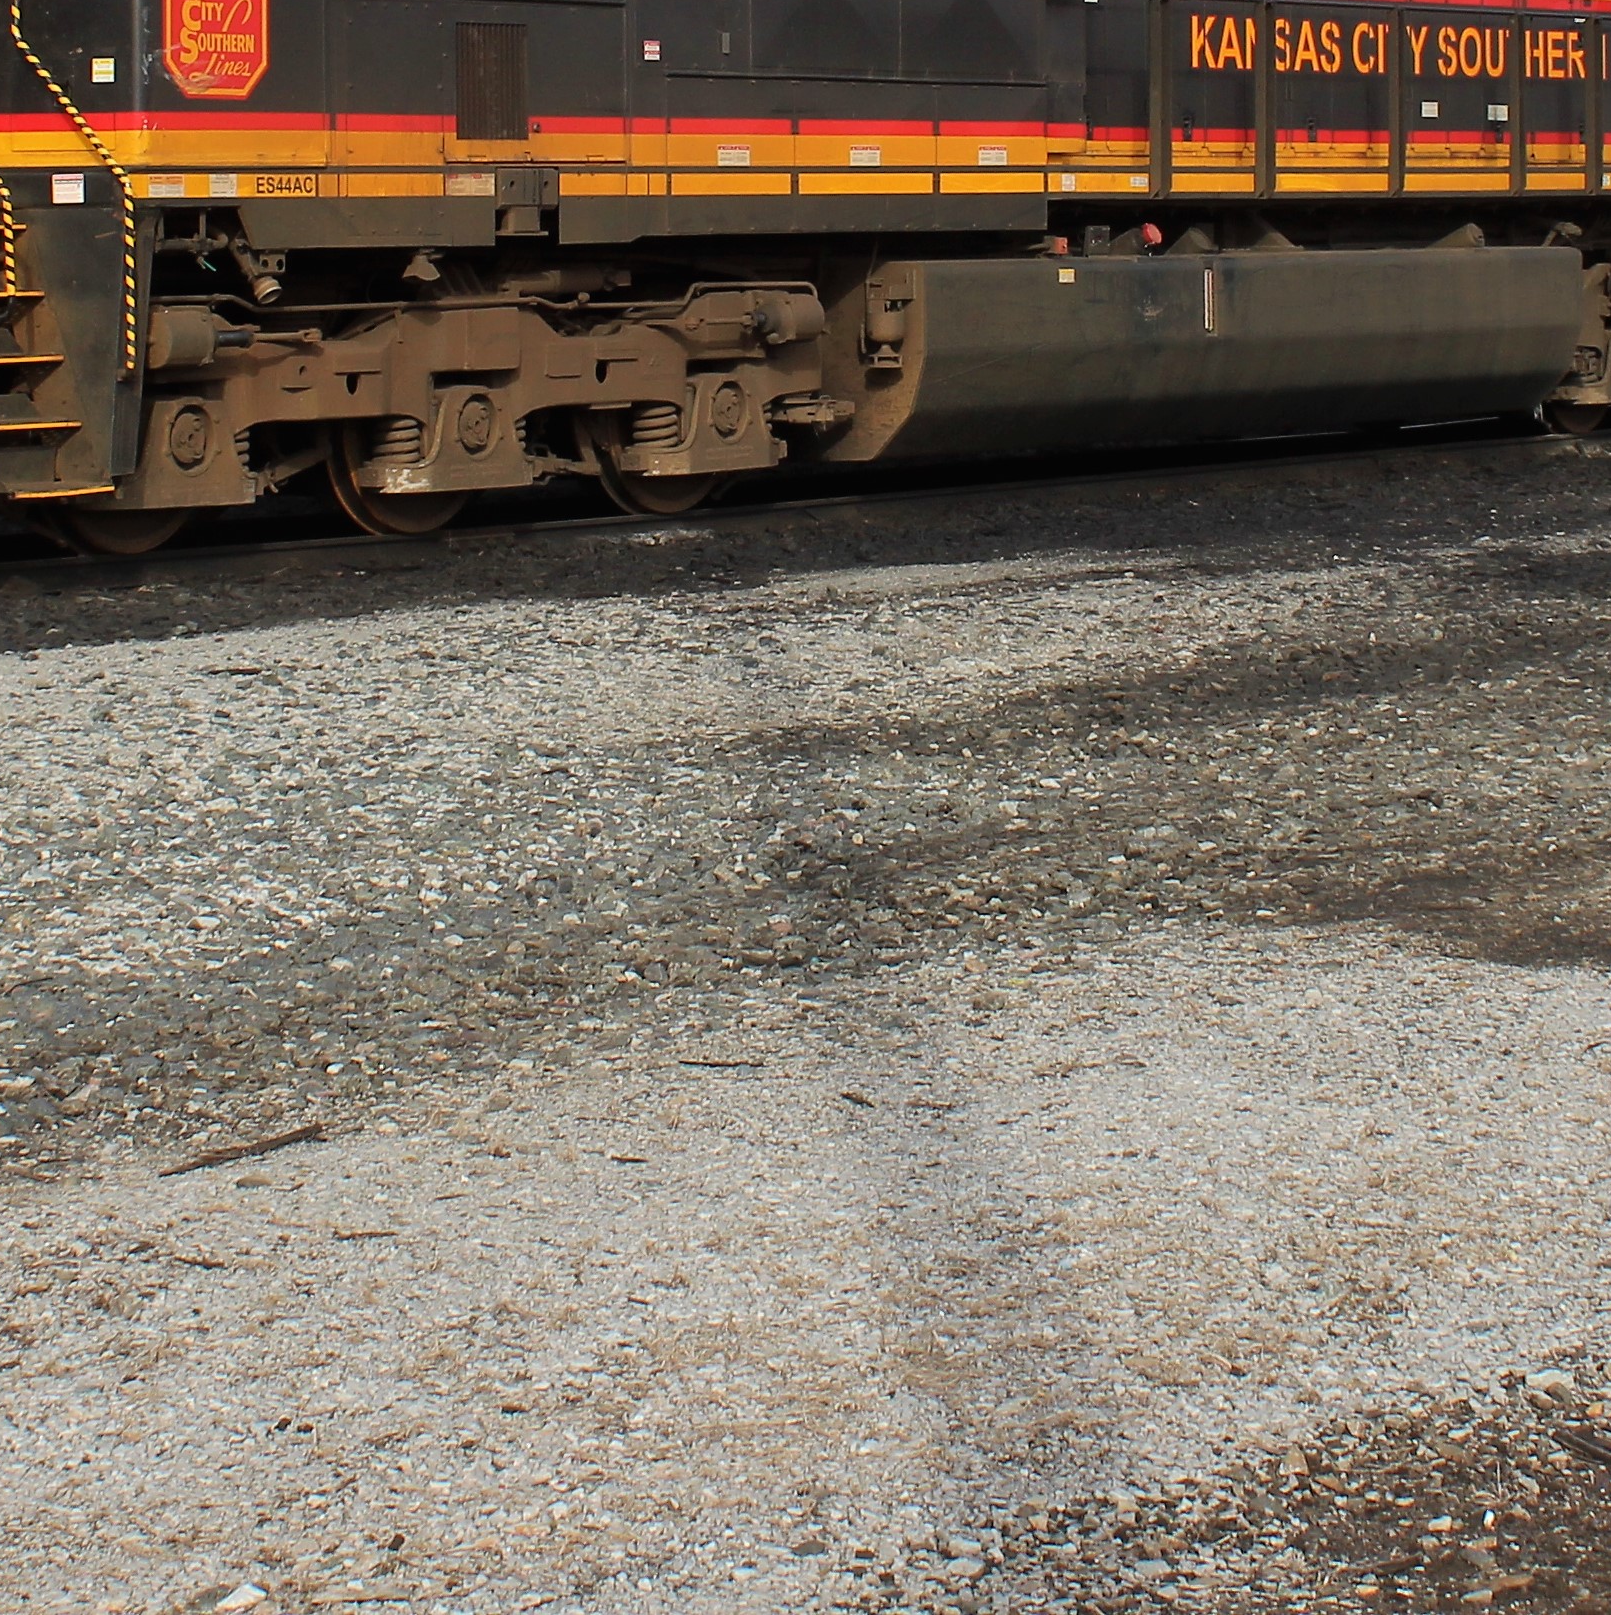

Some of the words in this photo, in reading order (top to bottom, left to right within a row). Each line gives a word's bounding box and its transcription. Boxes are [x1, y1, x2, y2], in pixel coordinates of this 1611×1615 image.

[181, 0, 224, 31] CITY
[179, 27, 255, 64] SOUTHERN
[1352, 21, 1428, 76] CIY
[1438, 26, 1608, 80] SOUHER
[256, 176, 314, 194] ES44AC
